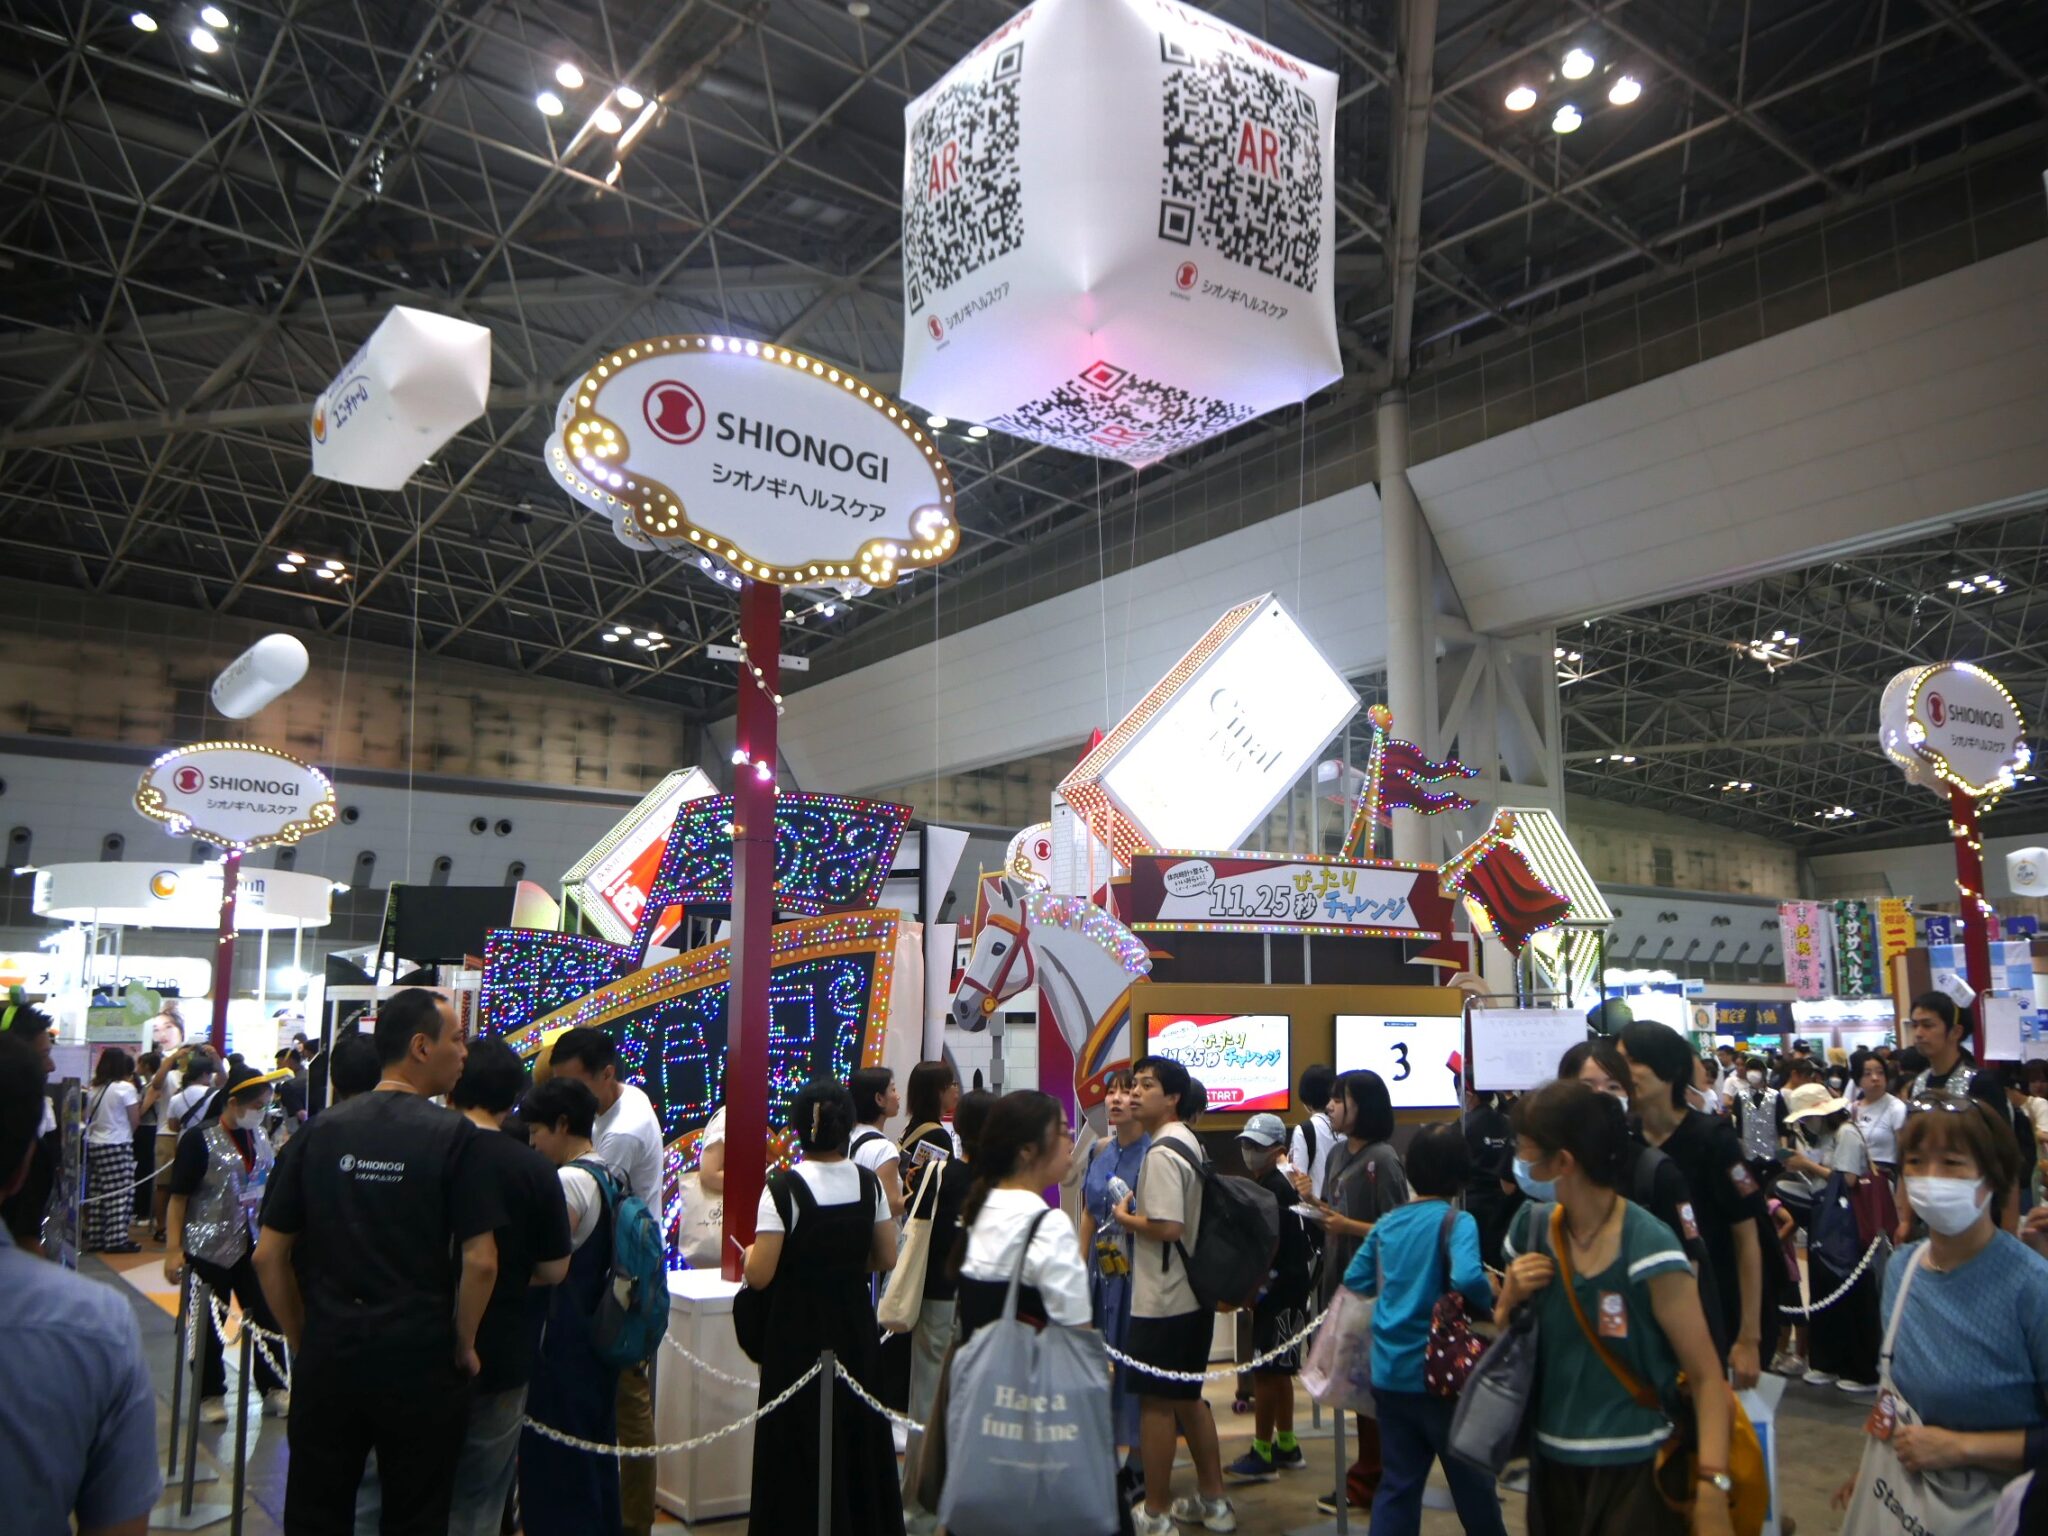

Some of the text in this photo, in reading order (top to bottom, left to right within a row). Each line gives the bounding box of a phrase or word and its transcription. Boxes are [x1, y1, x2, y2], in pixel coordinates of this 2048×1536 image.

[928, 140, 959, 201] AR
[1237, 120, 1280, 180] AR
[945, 281, 1010, 330] シオノギヘルスケア
[1201, 279, 1288, 320] シオノギヘルスケア
[716, 411, 889, 484] SHIONOGI
[713, 462, 887, 523] シオノギヘルスケア
[1948, 703, 2004, 730] SHIONOGI
[207, 798, 298, 815] シオノギヘルスケア
[209, 775, 300, 797] SHIONOGI
[1390, 1041, 1411, 1082] 3
[357, 1159, 405, 1172] SHIONOGI
[994, 1384, 1068, 1413] Hae a
